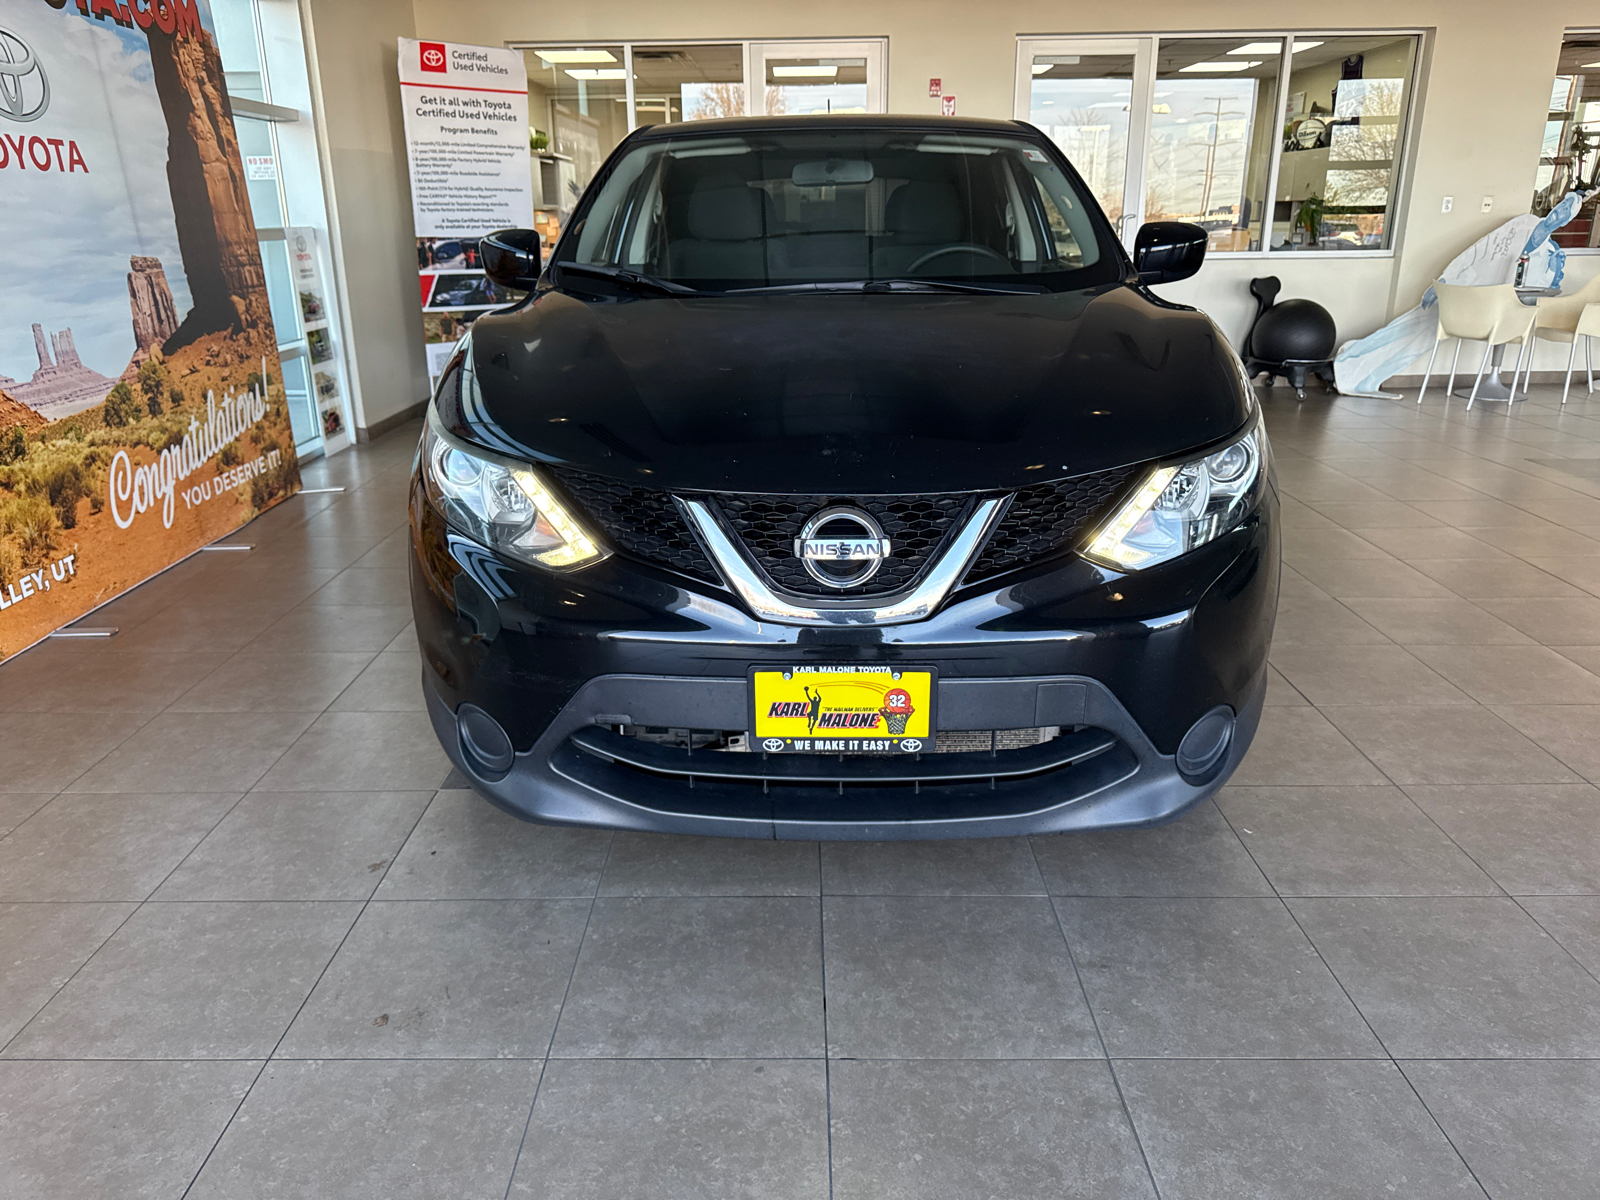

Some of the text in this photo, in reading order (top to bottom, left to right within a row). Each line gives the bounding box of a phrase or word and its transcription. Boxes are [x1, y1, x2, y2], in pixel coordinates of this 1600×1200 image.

[452, 50, 488, 62] Certified
[453, 61, 509, 75] Used Vehicles
[420, 95, 512, 111] Get it all with Toyota
[416, 107, 517, 122] Certified Used Vehicles
[440, 125, 498, 136] Program Benefits
[110, 355, 271, 529] Congratulations!
[181, 448, 283, 510] YOU DESERVE IT!
[805, 543, 880, 556] NISSAN
[50, 554, 75, 581] UT
[793, 666, 892, 674] KARL MALONE TOYOTA
[889, 694, 906, 708] 32
[767, 702, 810, 718] KARL
[817, 712, 881, 729] MALONE
[794, 740, 891, 750] WE MAKE IT EASY
